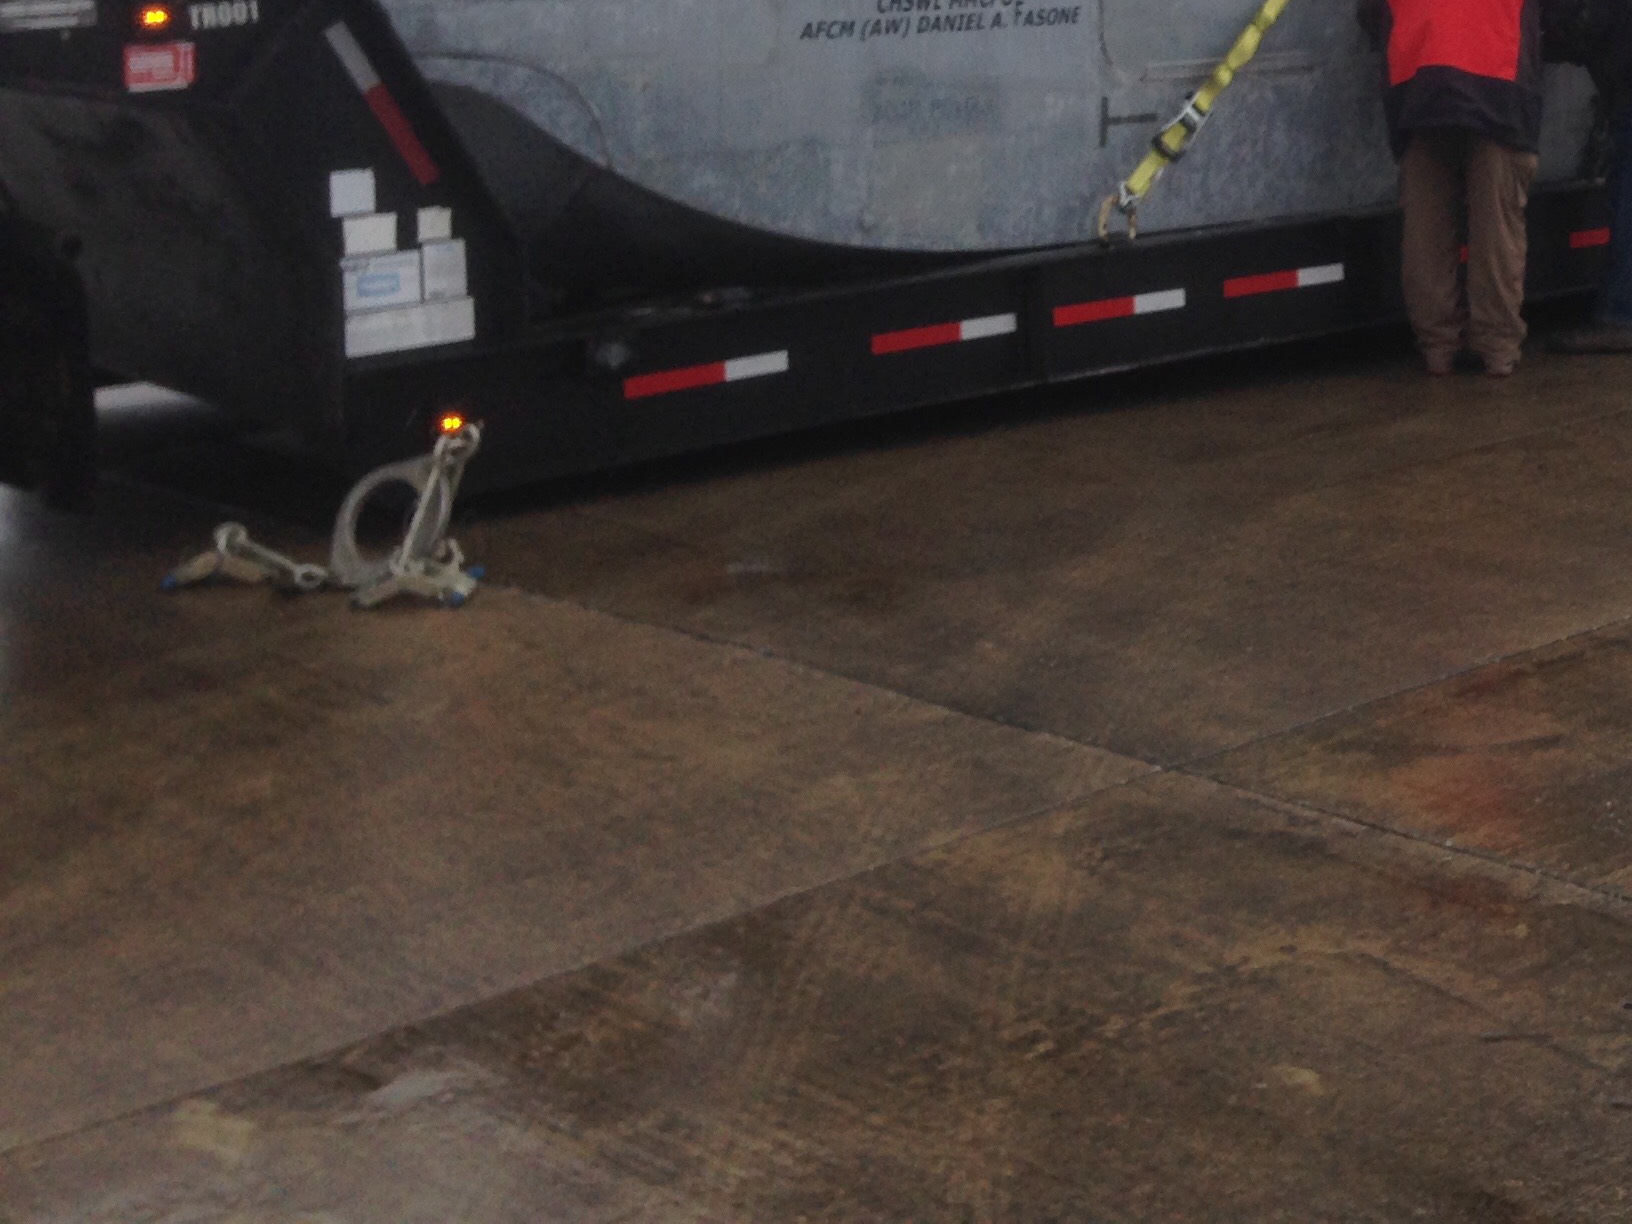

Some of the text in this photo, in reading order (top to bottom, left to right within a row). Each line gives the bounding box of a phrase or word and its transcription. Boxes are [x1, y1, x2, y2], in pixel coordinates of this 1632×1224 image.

[799, 19, 856, 41] AFCM
[860, 16, 911, 42] (AW)
[916, 11, 986, 34] DANIEL
